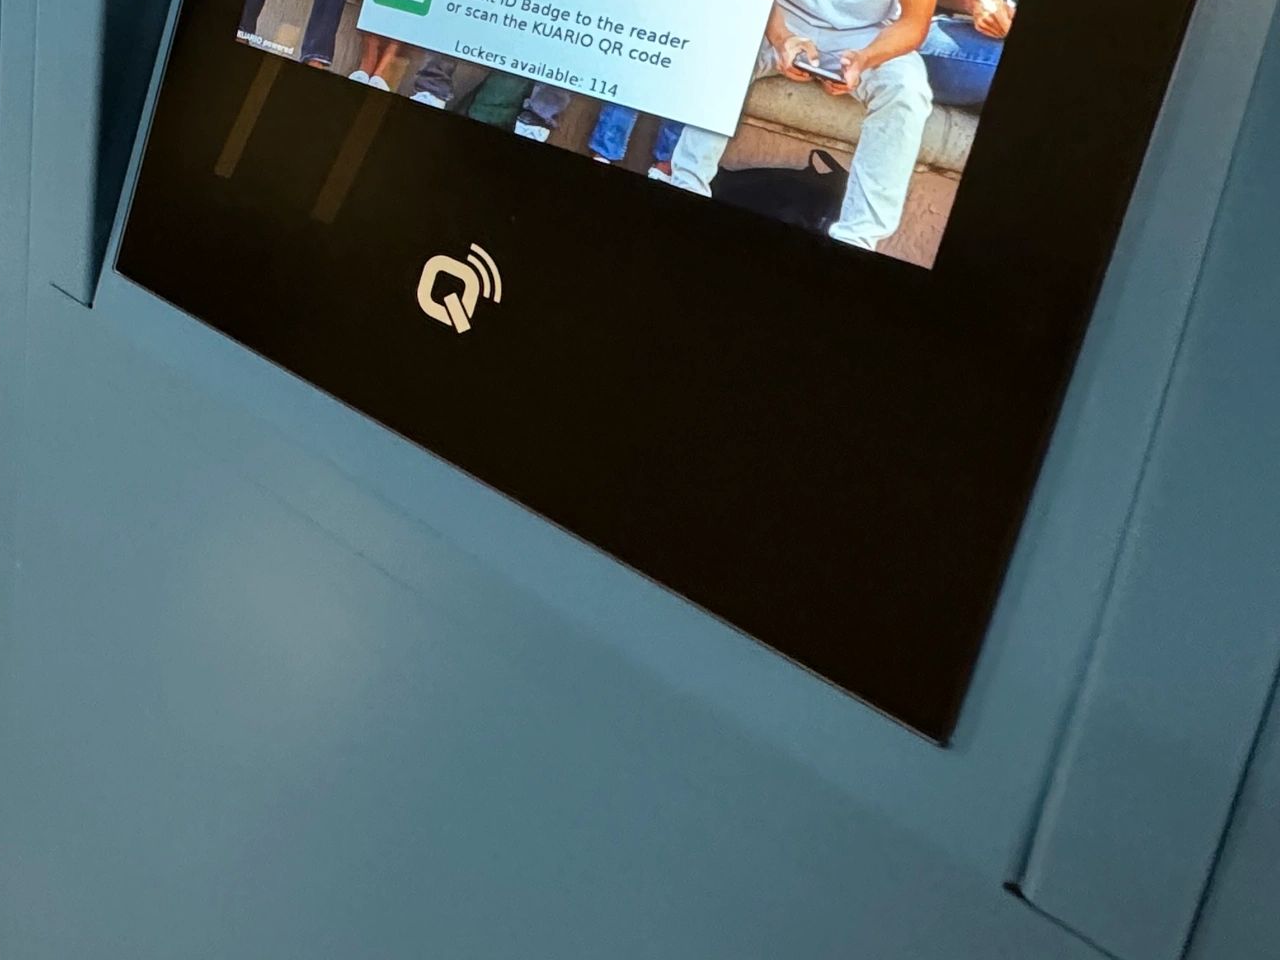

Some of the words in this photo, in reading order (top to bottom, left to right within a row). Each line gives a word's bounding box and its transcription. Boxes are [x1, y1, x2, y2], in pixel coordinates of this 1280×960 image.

[446, 0, 462, 14] or
[465, 5, 498, 24] scan
[503, 13, 528, 31] the
[532, 19, 594, 48] KUARIO
[598, 38, 623, 58] QR
[628, 43, 673, 68] code
[575, 10, 591, 27] to
[596, 14, 625, 35] the
[629, 25, 690, 51] reader
[454, 39, 506, 66] Lockers
[511, 56, 584, 87] available:
[590, 76, 619, 97] 114
